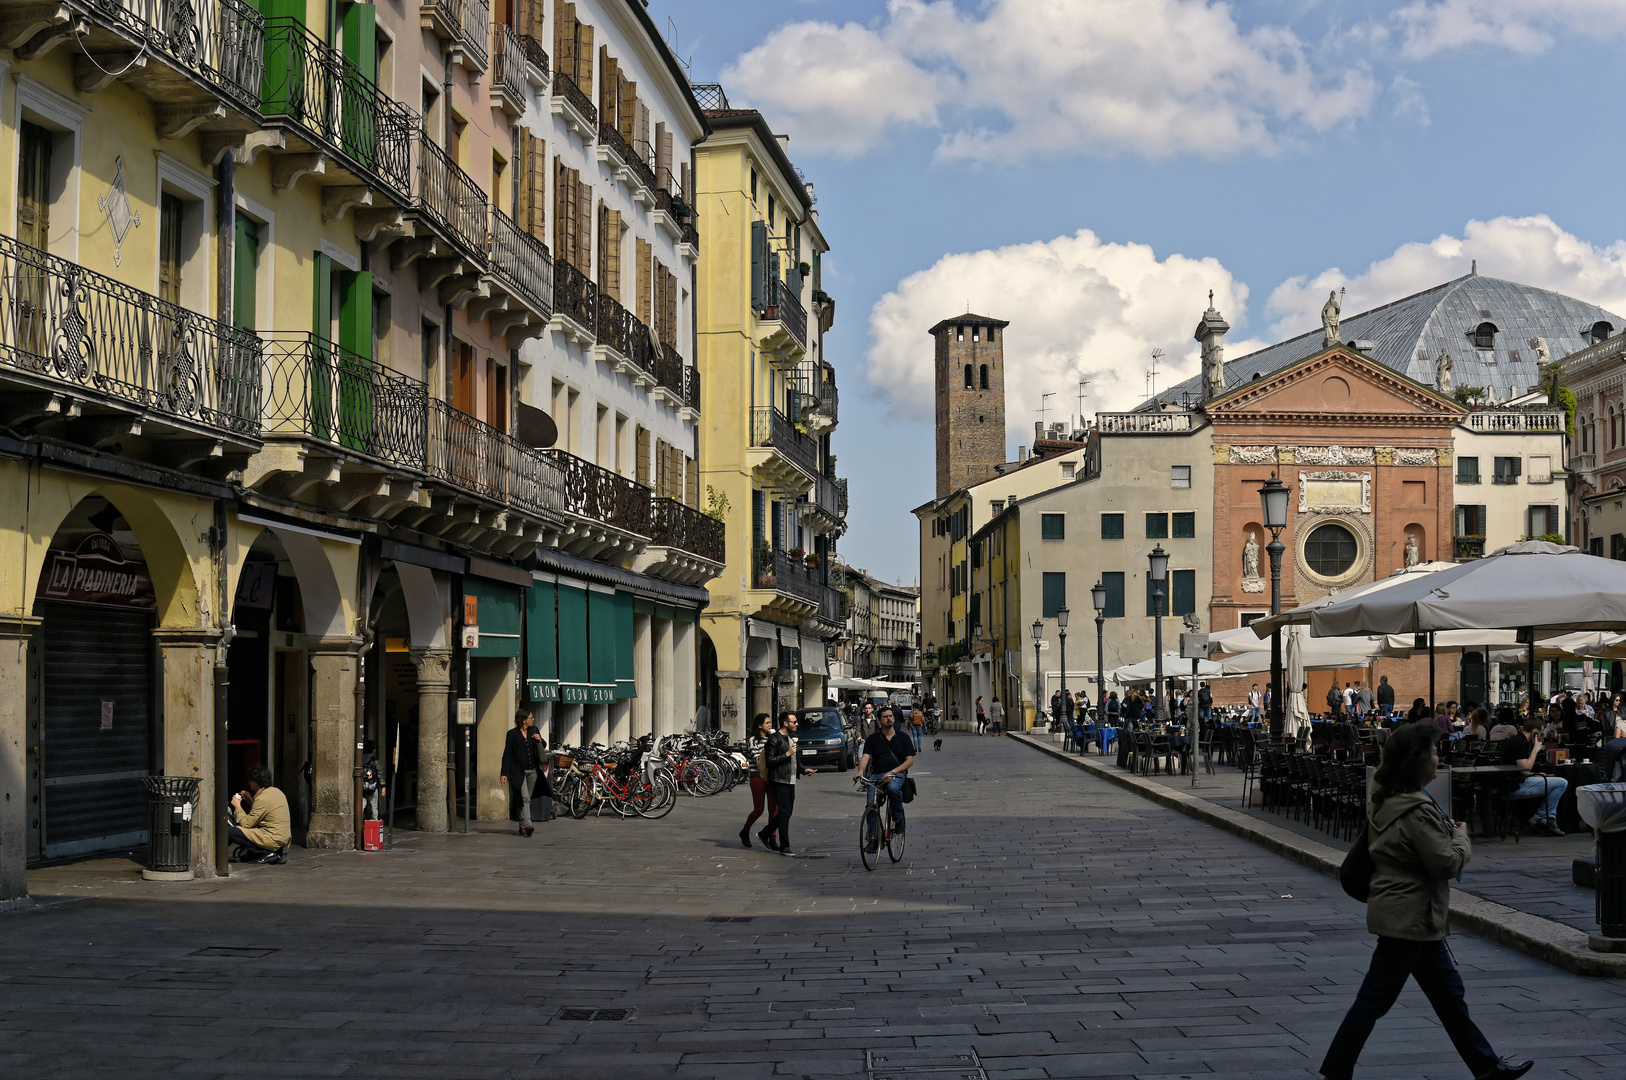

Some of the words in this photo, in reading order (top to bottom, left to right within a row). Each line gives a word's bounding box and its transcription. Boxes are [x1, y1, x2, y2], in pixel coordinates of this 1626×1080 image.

[52, 564, 70, 588] LA
[73, 567, 139, 596] PIADINERIA
[466, 603, 477, 618] TAXI
[533, 685, 556, 698] GROM
[593, 689, 614, 701] GROM
